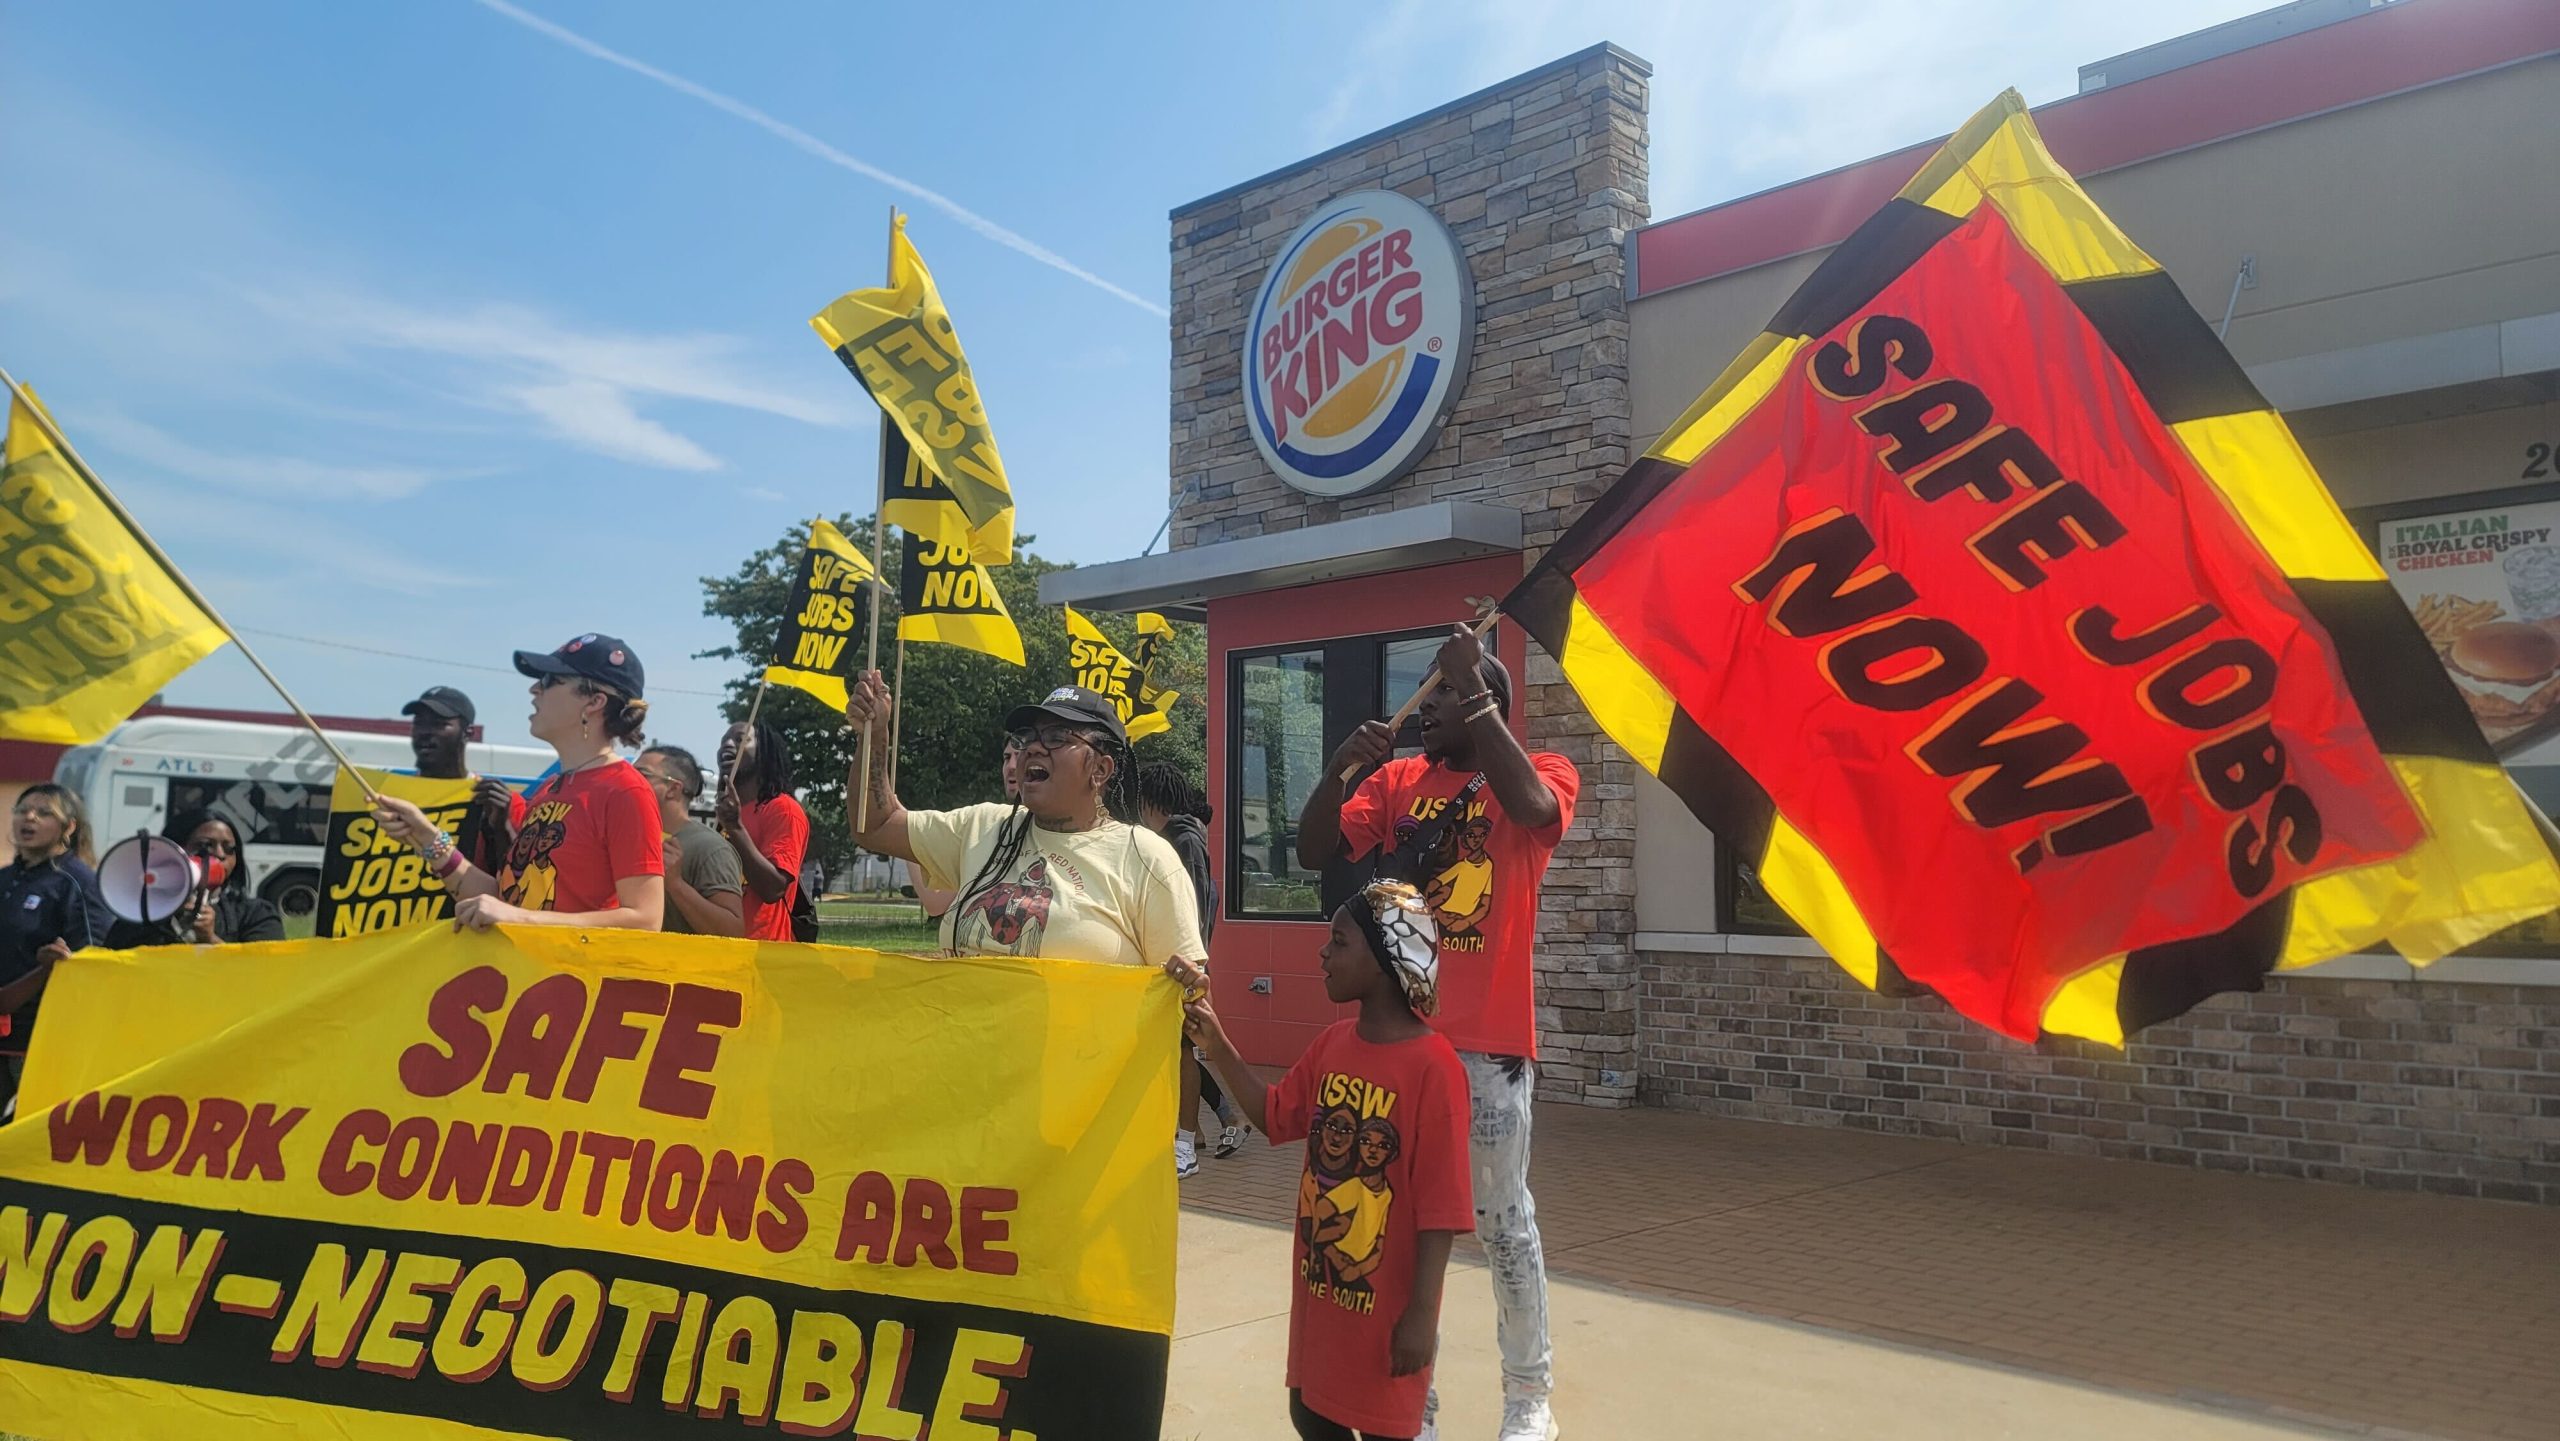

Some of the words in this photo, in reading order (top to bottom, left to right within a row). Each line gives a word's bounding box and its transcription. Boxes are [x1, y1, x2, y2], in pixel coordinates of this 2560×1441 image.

[1263, 228, 1413, 383] BURGER
[1270, 271, 1423, 450] KING
[2521, 441, 2560, 480] 2
[2396, 514, 2509, 543] ITALIAN
[2397, 538, 2467, 558] ROYAL
[808, 553, 860, 594] SAFE
[2397, 550, 2494, 572] CHICKEN
[797, 592, 855, 632] JOBS
[1806, 314, 2129, 594] SAFE
[2064, 602, 2323, 900] JOBS
[792, 631, 848, 671] NOW
[1730, 505, 2155, 876] NOW!
[156, 757, 198, 773] ATL
[1409, 796, 1488, 823] USW
[1048, 852, 1069, 868] RED
[332, 895, 448, 938] NOW
[1442, 935, 1485, 953] SOUTH
[398, 964, 743, 1120] SAFE
[1316, 1072, 1398, 1121] USSW
[48, 1090, 311, 1182] WORK
[318, 1108, 815, 1253] CONDITIONS
[834, 1170, 1019, 1276] ARE
[1308, 1279, 1328, 1299] HE
[1332, 1286, 1376, 1316] SOUTH
